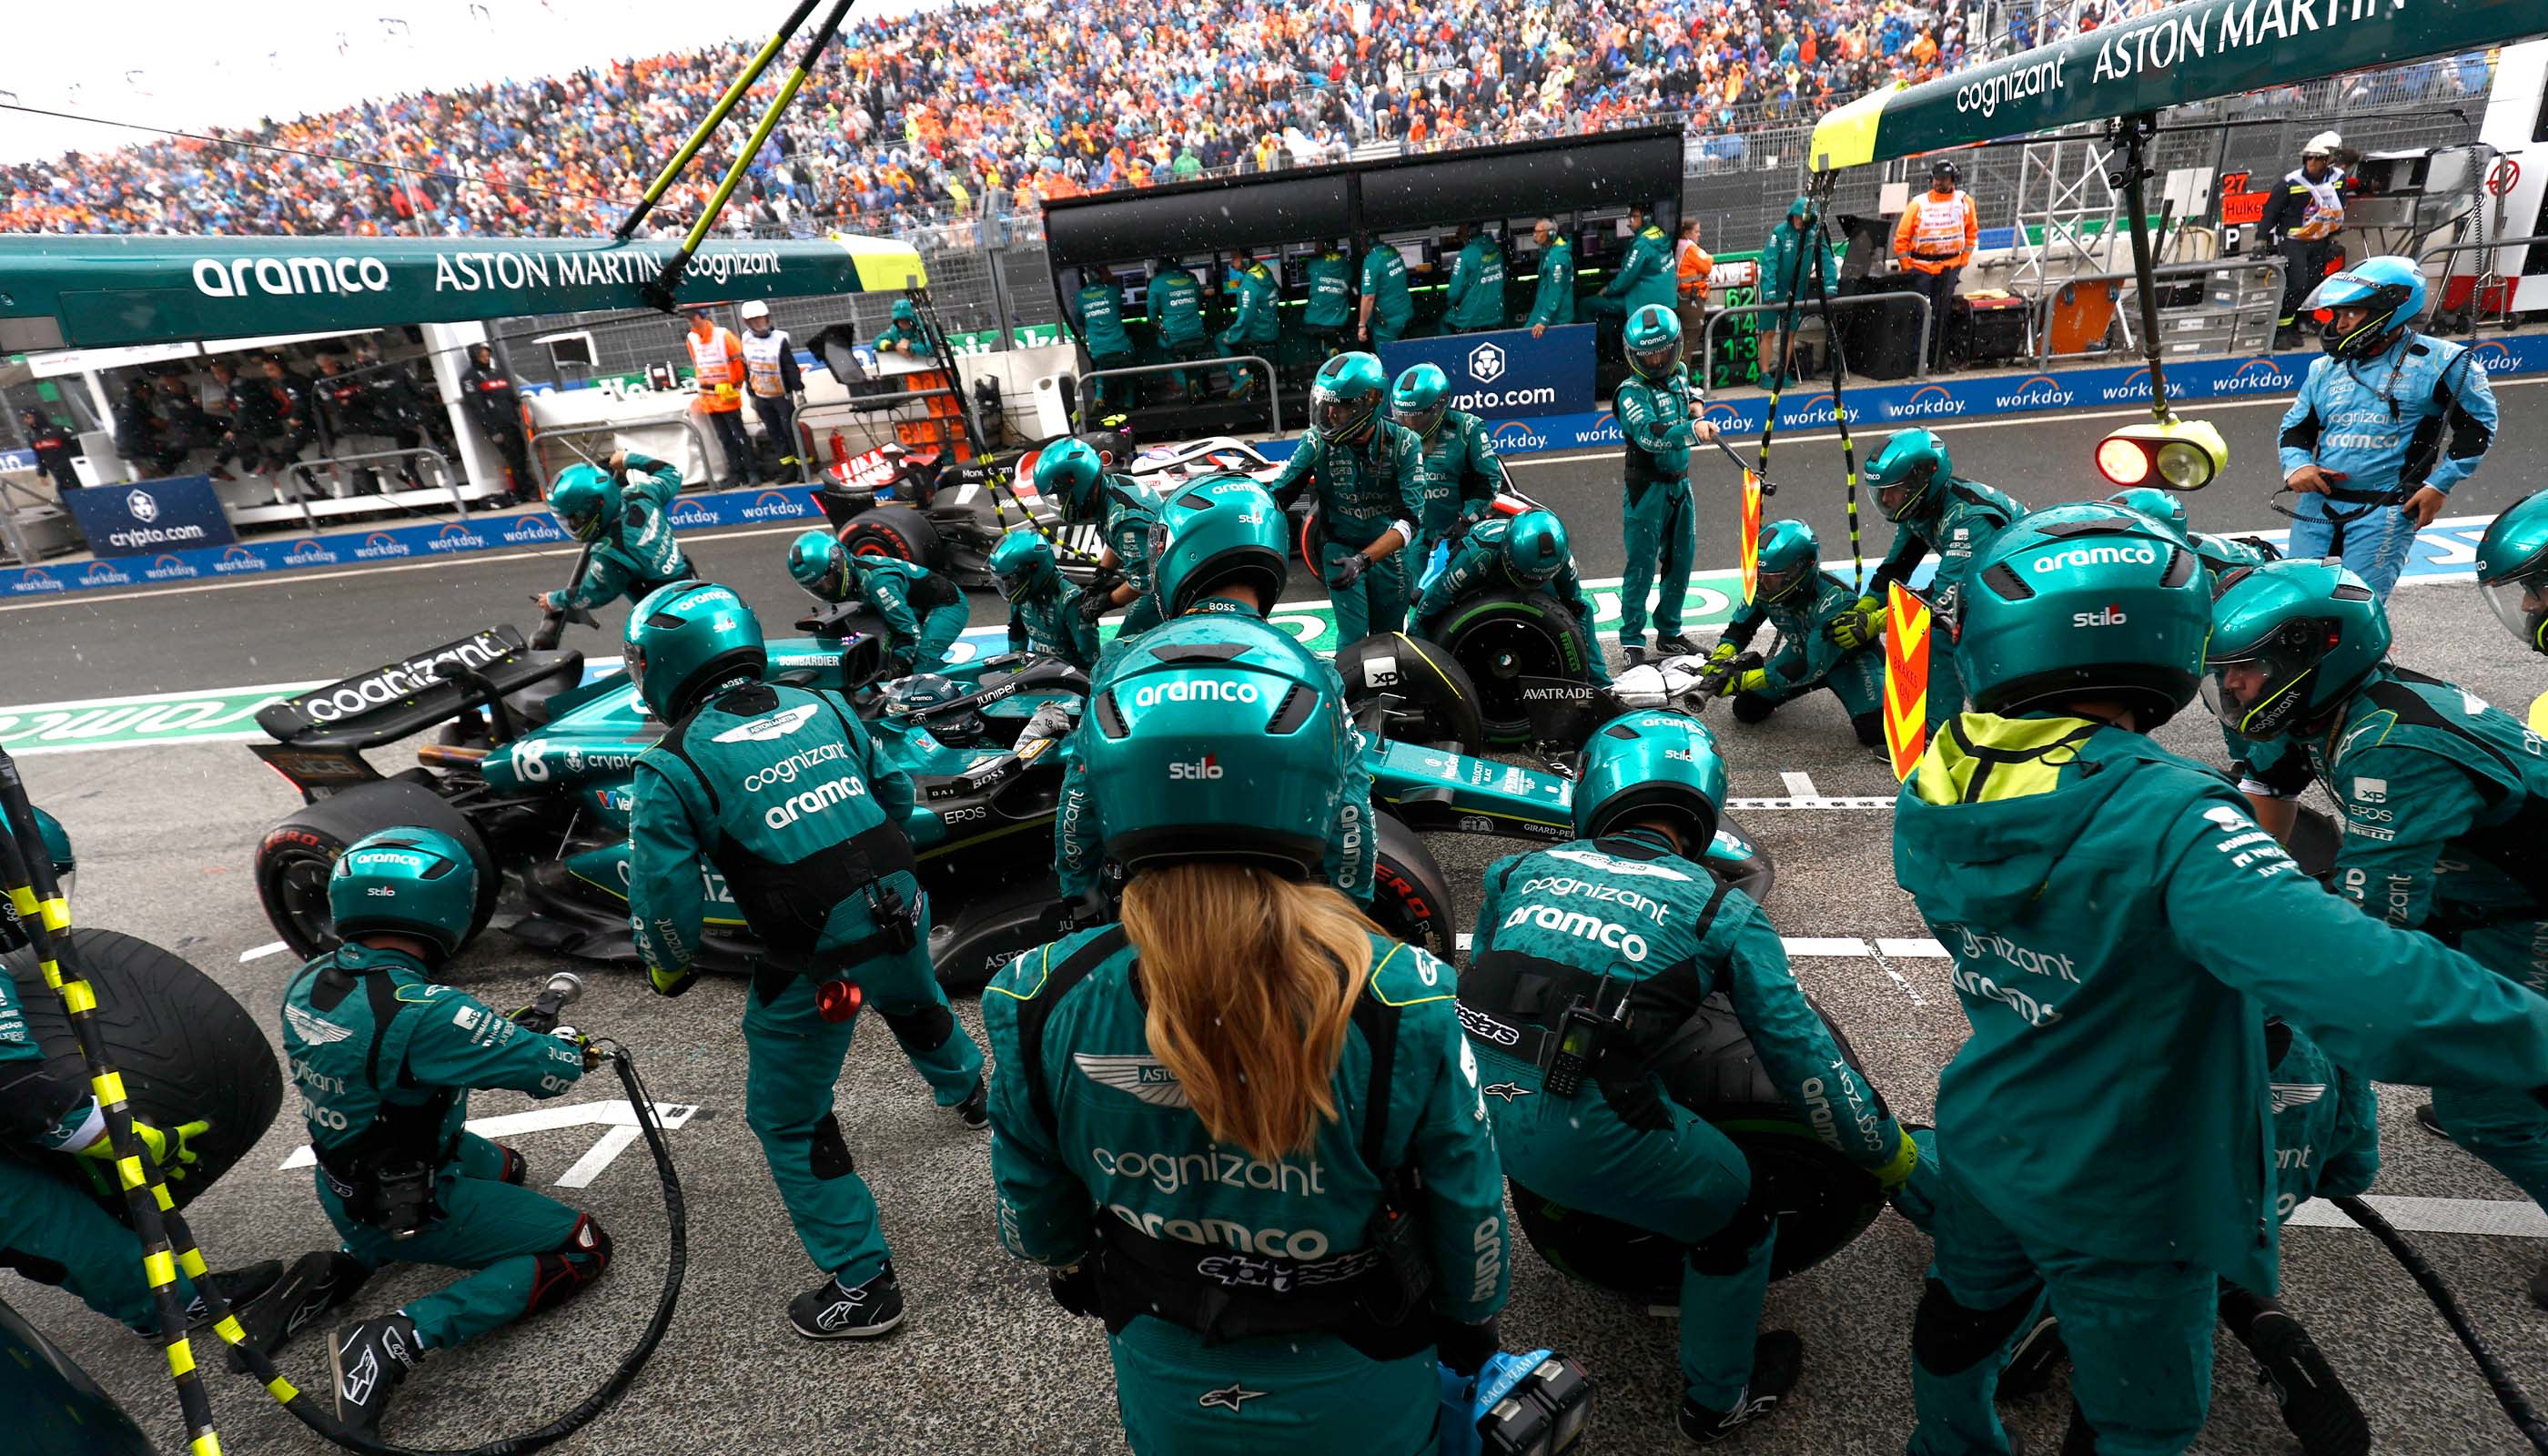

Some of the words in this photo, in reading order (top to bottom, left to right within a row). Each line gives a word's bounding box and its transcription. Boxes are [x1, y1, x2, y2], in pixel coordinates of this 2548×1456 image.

[1956, 51, 2066, 117] cognizant
[2093, 9, 2209, 84] ASTON
[2223, 175, 2247, 193] 27
[2226, 200, 2262, 217] Hulke
[193, 256, 389, 298] aramco
[436, 251, 550, 292] ASTON
[555, 249, 666, 287] MARTIN
[685, 248, 781, 278] cognizant
[1725, 288, 1755, 308] 62
[1639, 334, 1667, 346] aramco
[2478, 352, 2523, 371] kday
[1451, 387, 1555, 411] ypto.com
[1576, 426, 1624, 442] work
[2326, 433, 2400, 449] aramco
[1339, 504, 1393, 520] aramco
[109, 524, 205, 548] crypto.com
[2034, 547, 2155, 573] aramco
[679, 591, 733, 611] aramco
[1208, 601, 1236, 613] BOSS
[2073, 605, 2128, 628] Stilo
[779, 655, 839, 666] BOMBARDIER
[307, 633, 503, 722] cogniznt
[1894, 655, 1918, 688] BRAKES
[722, 677, 744, 689] BOSS
[1136, 679, 1259, 707] aramco
[1523, 687, 1594, 700] AVATRADE
[1900, 682, 1910, 701] ON
[2250, 690, 2301, 733] cognizant
[749, 720, 772, 734] ASTON
[773, 713, 798, 728] MARTIN
[1642, 716, 1706, 737] aramco
[511, 739, 549, 782] 18
[1664, 748, 1694, 762] Stilo
[744, 741, 848, 793] cognizant
[1168, 756, 1224, 780] Stilo
[973, 768, 1005, 790] BOSS
[765, 776, 864, 829] aramco
[945, 806, 986, 824] EPOS
[2350, 804, 2393, 823] EPOS
[1063, 788, 1085, 870] cognizant
[1460, 819, 1493, 833] FIA
[1338, 805, 1361, 889] aramco
[357, 854, 420, 865] aramco
[368, 885, 396, 897] Stilo
[1375, 863, 1432, 918] ERO
[1522, 876, 1670, 927] cognizant
[1503, 904, 1648, 962] aramco
[1143, 1068, 1179, 1083] ASTO
[1093, 1144, 1326, 1198] cognizant
[1108, 1203, 1329, 1261] aramco
[1480, 1379, 1507, 1407] RACE
[1505, 1358, 1534, 1381] TEAM
[1532, 1351, 1542, 1366] 2
